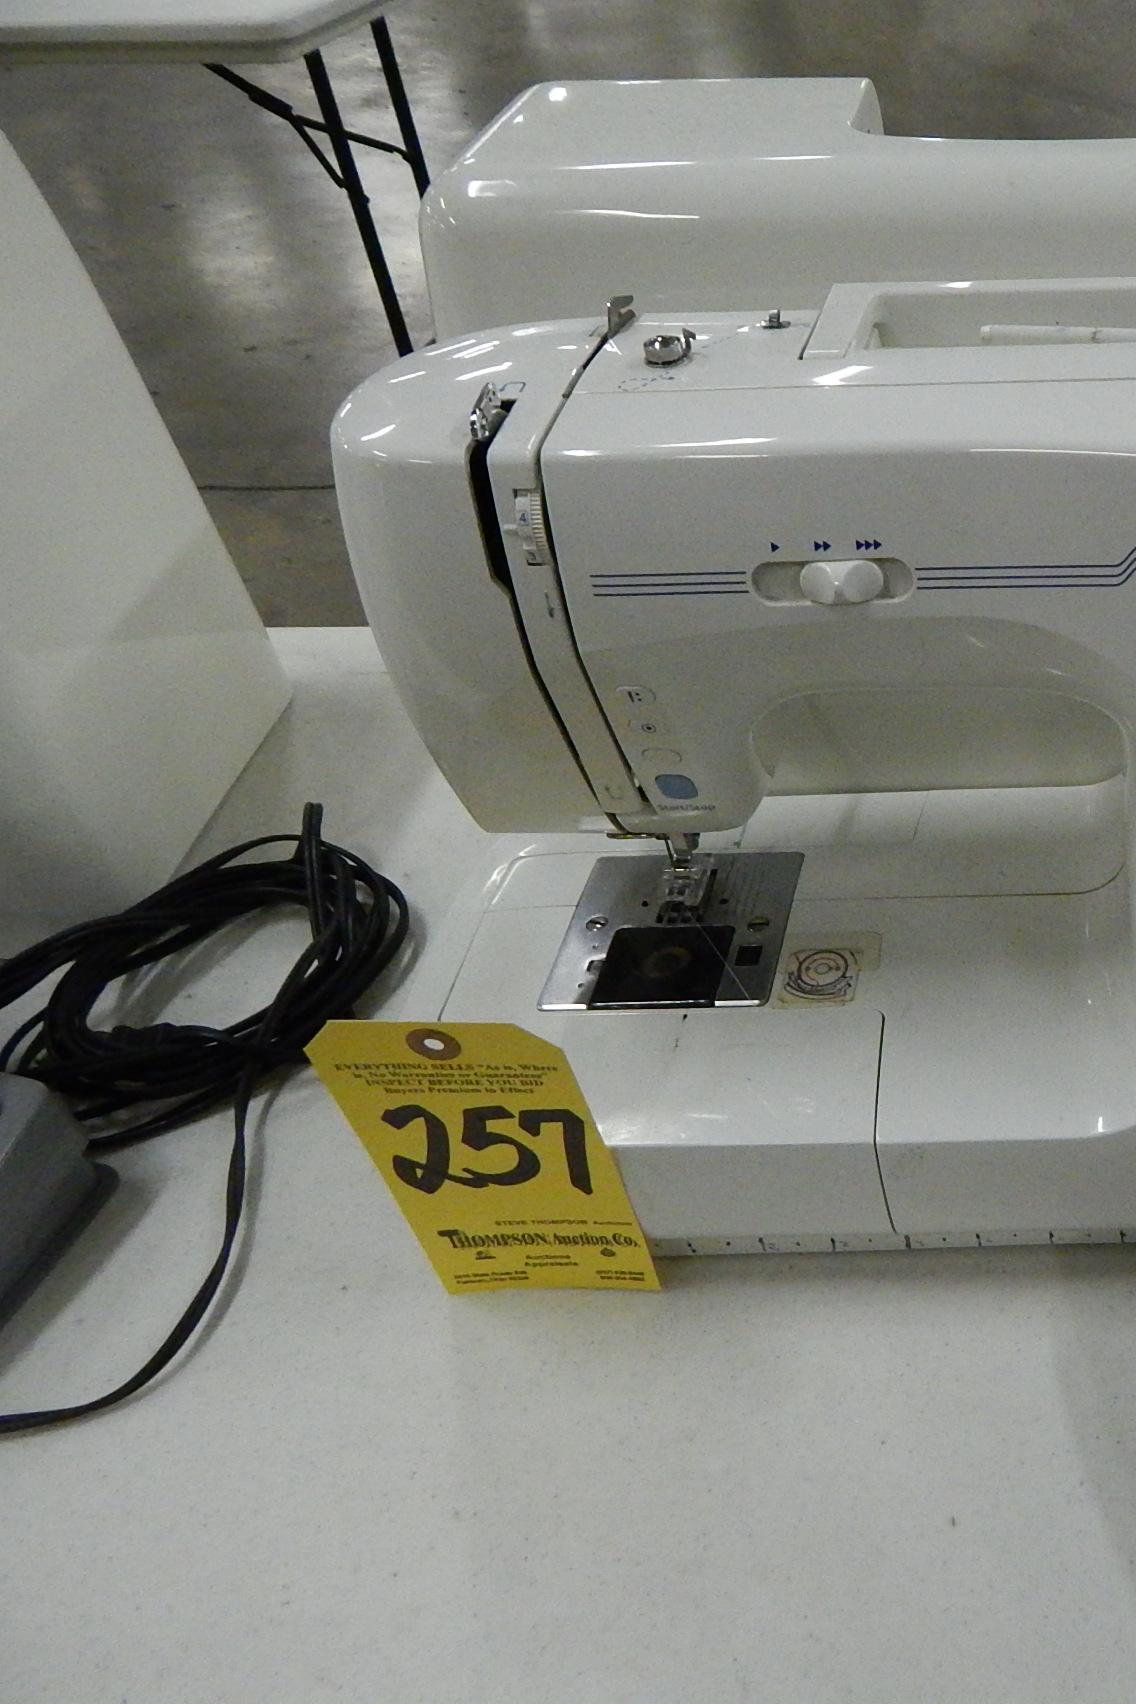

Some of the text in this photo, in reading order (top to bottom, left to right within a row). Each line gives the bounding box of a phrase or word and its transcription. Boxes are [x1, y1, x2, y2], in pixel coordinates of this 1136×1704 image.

[518, 511, 529, 523] 4
[656, 803, 717, 813] Start/Stop
[334, 1063, 428, 1071] EVERYTHING
[431, 1063, 475, 1071] SELLS
[518, 1064, 559, 1072] Where
[365, 1079, 423, 1087] INSPECT
[427, 1079, 485, 1087] BEFORE
[520, 1079, 544, 1087] BID
[384, 1087, 426, 1095] Buyers
[499, 1086, 535, 1094] Effect
[381, 1103, 594, 1195] 257
[436, 1228, 548, 1249] THOMPSON
[553, 1231, 611, 1247] Auction
[524, 1260, 579, 1268] Appraisals
